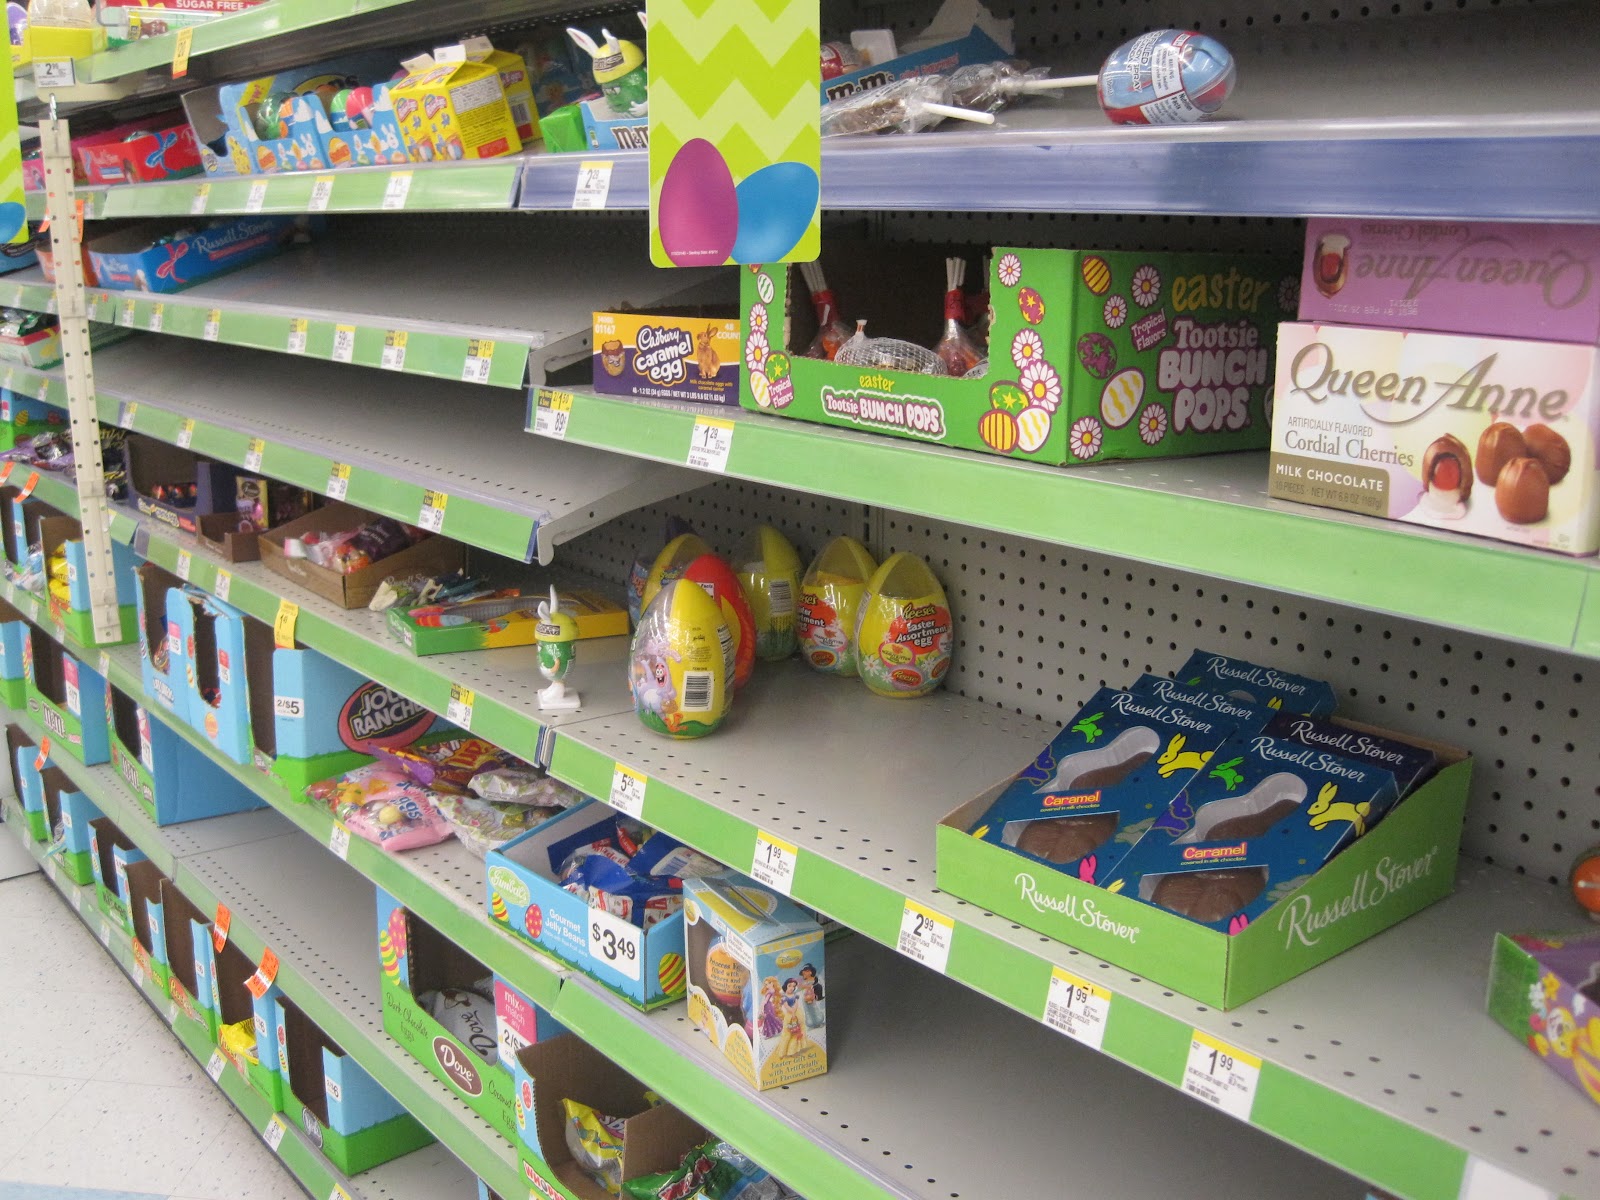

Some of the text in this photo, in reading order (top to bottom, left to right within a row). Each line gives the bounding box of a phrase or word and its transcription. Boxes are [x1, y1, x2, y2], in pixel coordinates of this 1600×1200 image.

[176, 0, 245, 11] SUGAR FREE
[1172, 266, 1270, 312] easter
[1455, 248, 1594, 311] Queen
[1131, 308, 1166, 338] Tropical
[1174, 320, 1259, 349] Tootsie
[636, 334, 692, 371] caramel
[638, 328, 680, 351] Cadbury
[1136, 327, 1167, 352] Flavors
[650, 359, 683, 382] egg
[859, 374, 895, 392] easter
[1159, 349, 1267, 389] BUNCH
[1289, 342, 1570, 422] Queen Anne
[768, 375, 792, 396] Tropical
[773, 392, 794, 408] Flavors
[825, 394, 940, 433] Tootsie BUNCH POPS
[1173, 387, 1250, 433] POPS
[1288, 416, 1373, 438] ARTIFICIALLY FLAVORED
[1285, 431, 1414, 468] Cordial Cherries
[1276, 463, 1384, 492] MILK CHOCOLATE
[895, 626, 948, 643] Assortment
[906, 620, 936, 633] Easter
[914, 636, 933, 648] egg
[1206, 656, 1306, 697] Russell Stover
[277, 699, 300, 715] 2/$5
[362, 687, 405, 716] JOL
[1111, 693, 1213, 735] Russell Stover
[1152, 680, 1253, 721] Russell Stover
[1290, 720, 1404, 766] Russell Stover
[1251, 736, 1367, 784] Russell Stover
[1044, 791, 1101, 806] Caramel
[1183, 842, 1247, 859] Caramel
[1014, 872, 1138, 944] Russell Stover
[1278, 856, 1433, 950] Russell Stover
[545, 918, 586, 948] Jelly Beans
[549, 908, 581, 933] Gourmet
[504, 990, 519, 1011] mix
[505, 1004, 526, 1027] match
[440, 1043, 475, 1083] Dove
